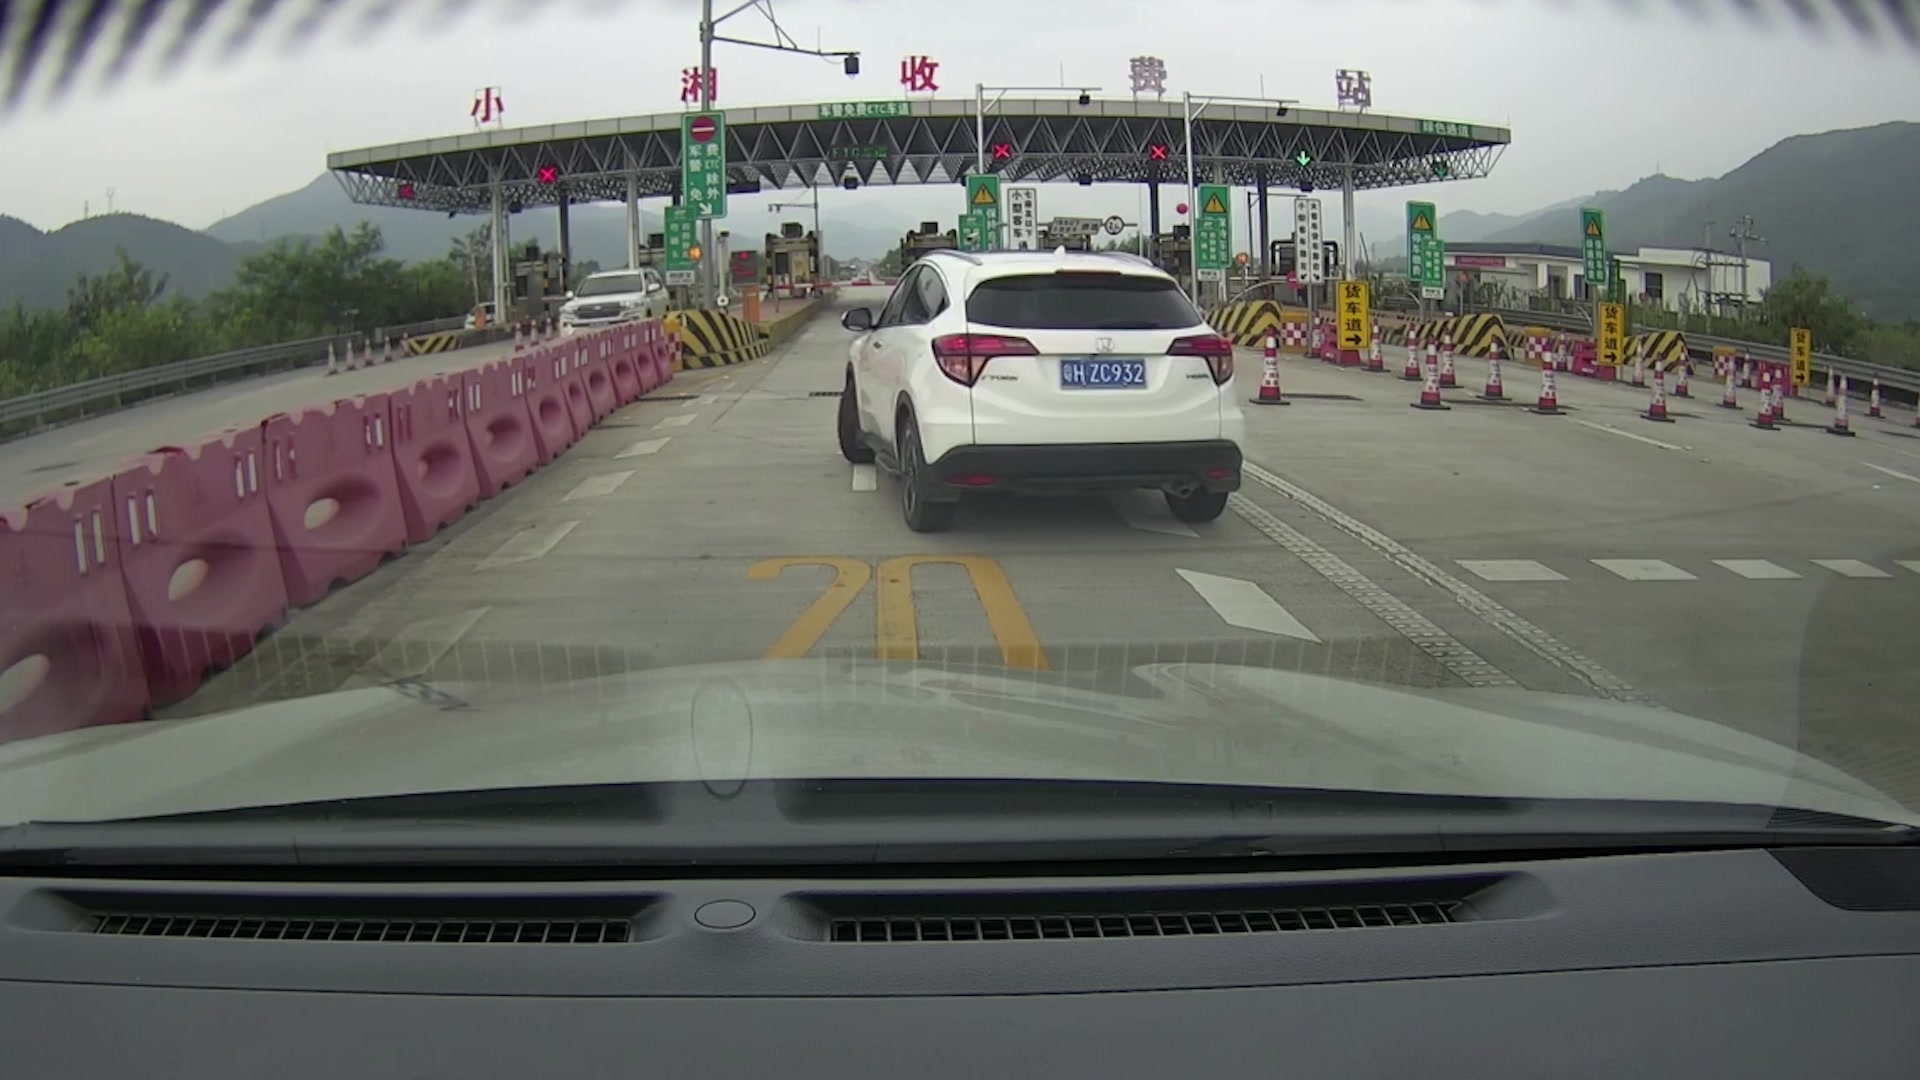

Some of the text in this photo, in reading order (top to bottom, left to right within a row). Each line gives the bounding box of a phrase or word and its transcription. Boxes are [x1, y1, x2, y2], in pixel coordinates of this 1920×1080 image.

[1421, 120, 1470, 138] 绿色通道
[1344, 284, 1362, 332] 货车道
[1604, 306, 1618, 351] 货车道
[746, 554, 1050, 671] 20
